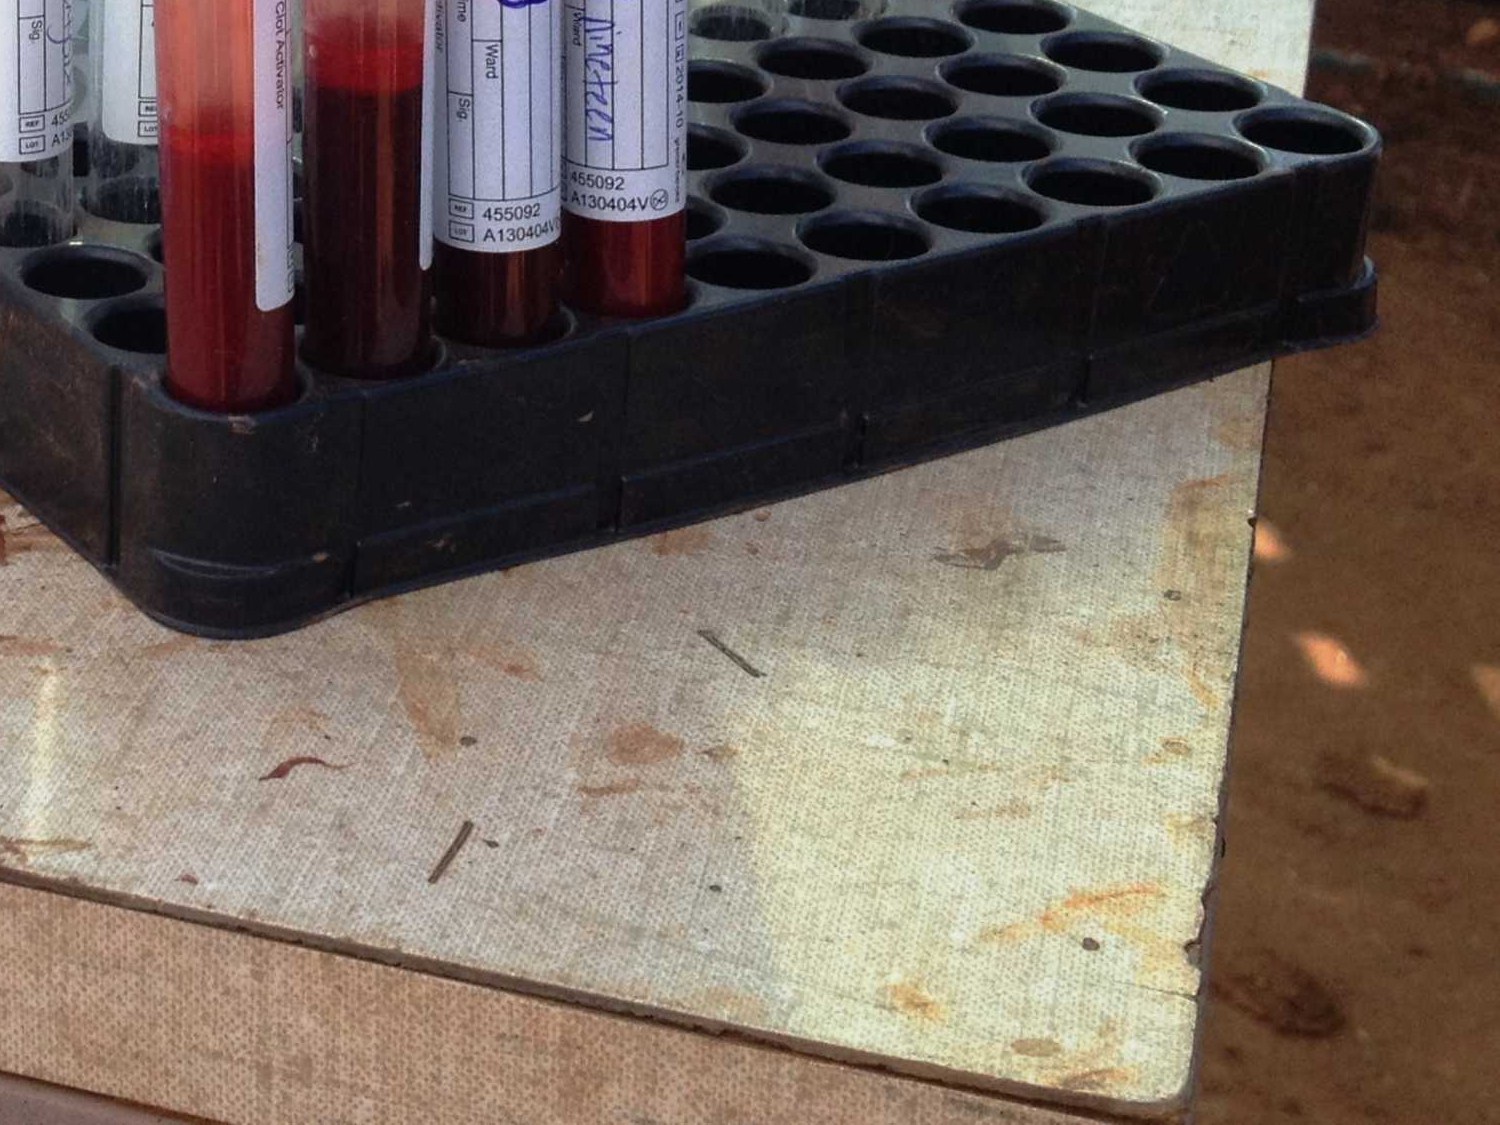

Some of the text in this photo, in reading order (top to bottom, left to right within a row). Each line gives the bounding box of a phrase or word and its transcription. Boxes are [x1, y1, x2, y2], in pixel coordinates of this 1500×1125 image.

[274, 0, 286, 35] Clot
[276, 38, 286, 110] Activator
[485, 43, 499, 80] Ward
[675, 66, 685, 129] 2014-10
[570, 171, 625, 192] 455092
[481, 202, 541, 222] 455092
